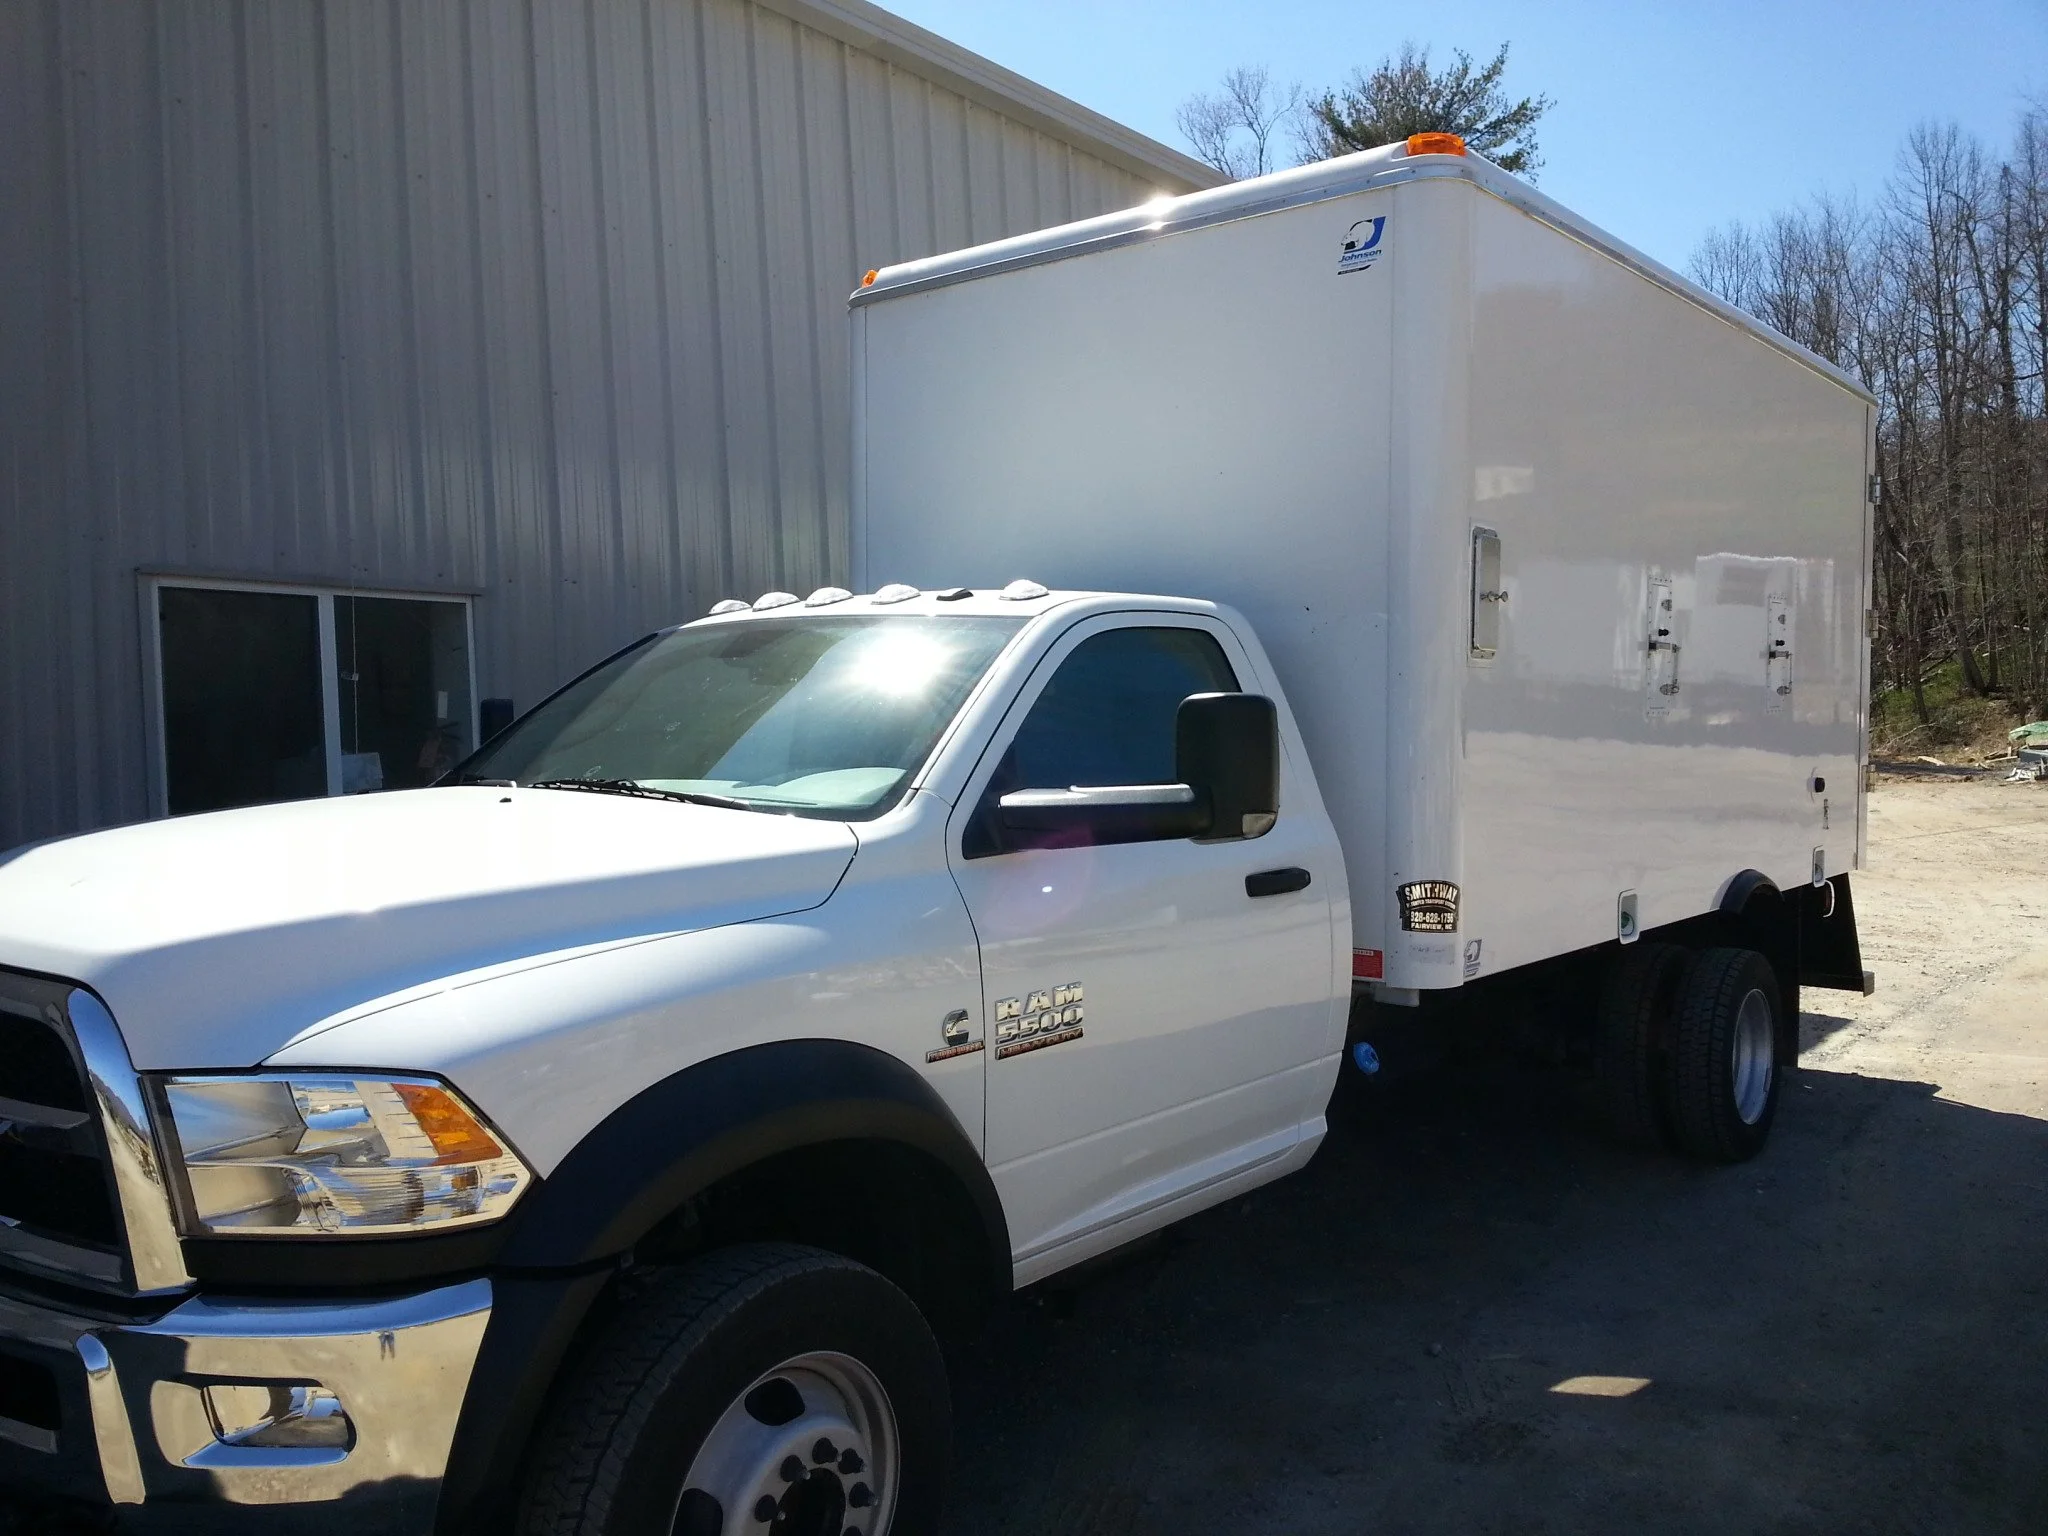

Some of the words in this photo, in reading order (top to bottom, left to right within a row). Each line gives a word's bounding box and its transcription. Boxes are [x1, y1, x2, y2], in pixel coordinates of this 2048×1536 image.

[1338, 249, 1382, 263] Johnson
[1404, 883, 1458, 902] SMITHWAY
[995, 981, 1083, 1022] RAM
[995, 1004, 1083, 1045] 5500
